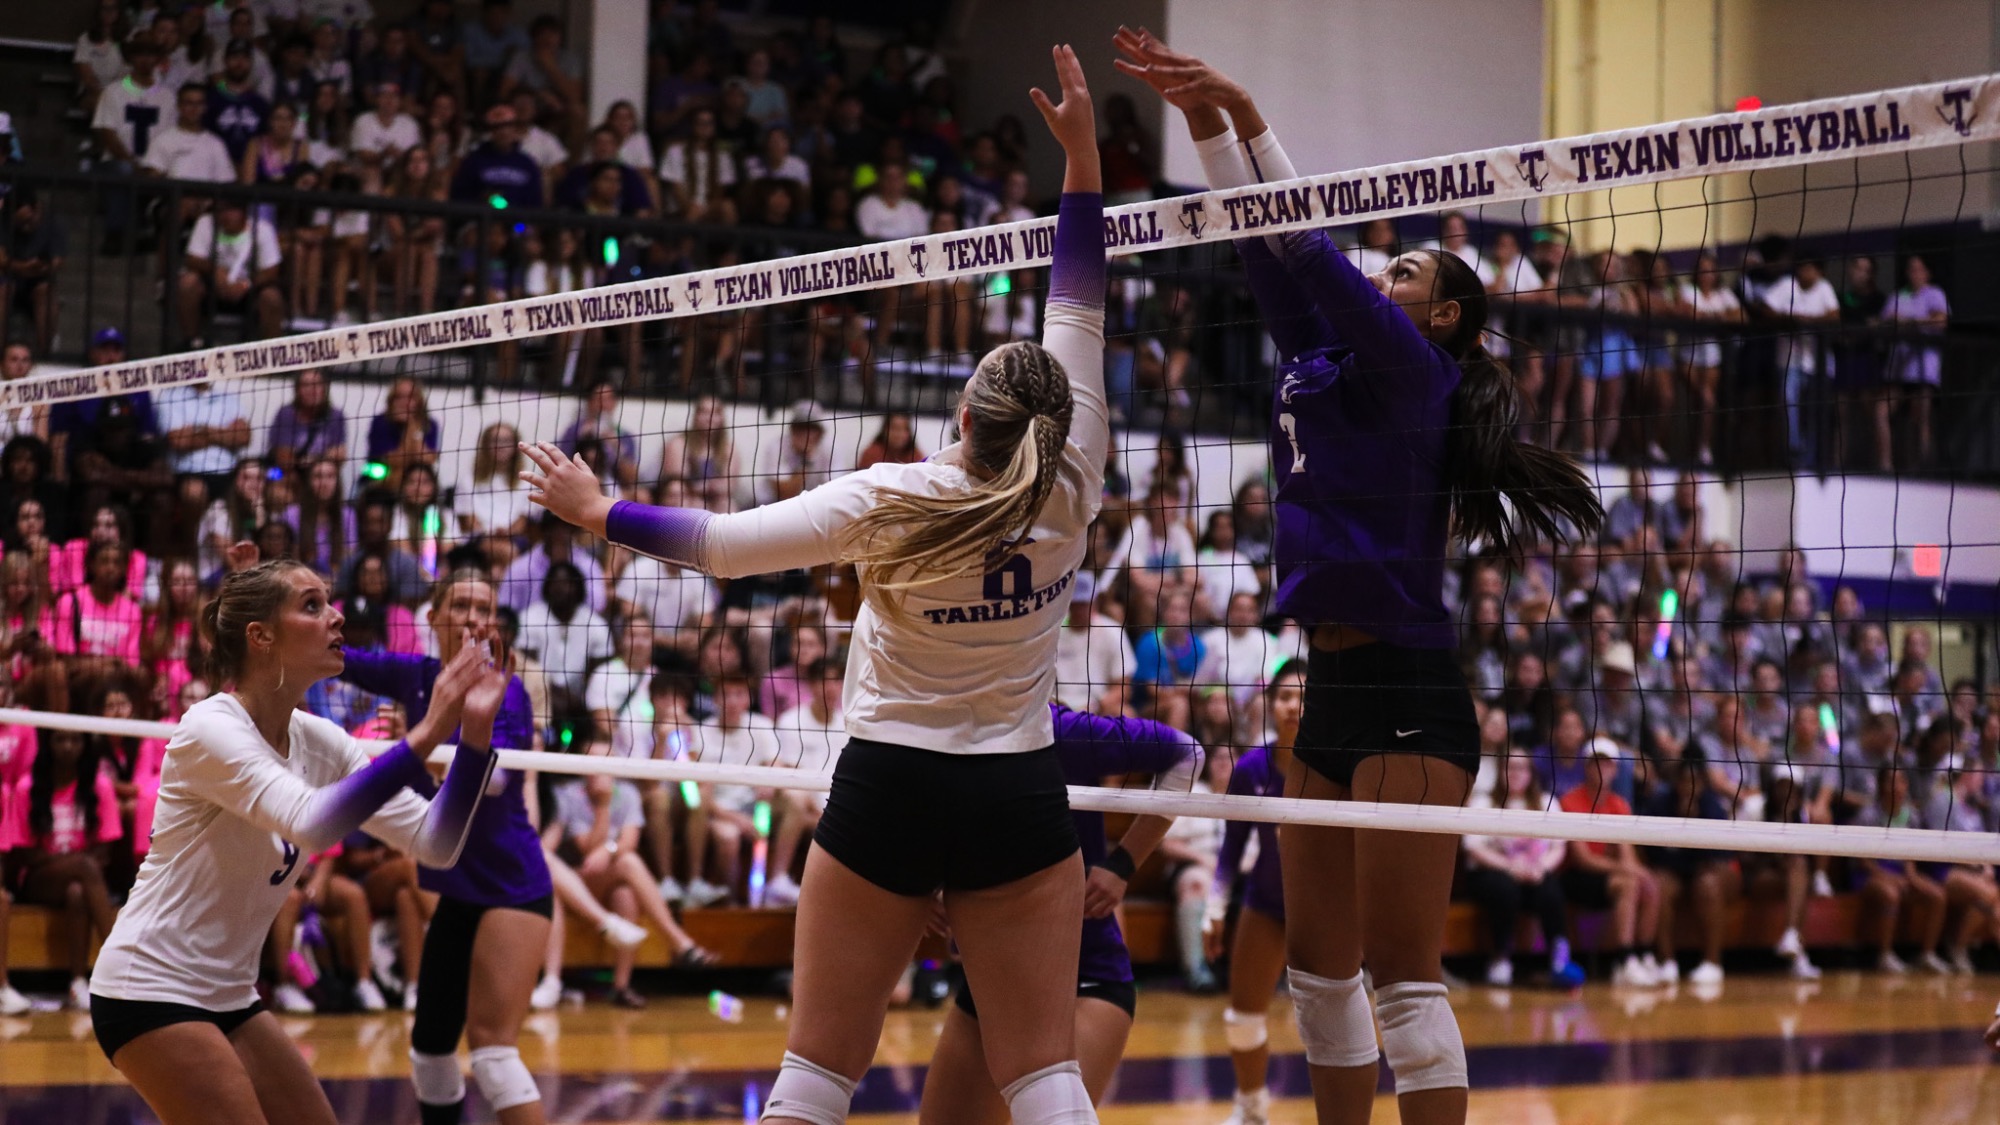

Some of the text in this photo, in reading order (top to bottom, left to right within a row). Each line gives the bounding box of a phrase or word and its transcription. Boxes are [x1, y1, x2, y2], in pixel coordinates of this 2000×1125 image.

[125, 103, 160, 157] T
[233, 345, 268, 372] TEXAN
[270, 338, 339, 367] VOLLEYBALL
[368, 326, 409, 354] TEXAN
[410, 314, 491, 348] VOLLEYBALL
[525, 300, 574, 331] TEXAN
[578, 287, 674, 323] VOLLEYBALL
[715, 271, 772, 305] TEXAN
[778, 251, 895, 296] VOLLEYBALL
[943, 232, 1014, 271] TEXAN
[1020, 211, 1163, 260] VOLBALL
[1223, 186, 1312, 231] TEXAN
[1318, 160, 1495, 218] VOLLEYBALL
[1570, 131, 1680, 183] TEXAN
[1689, 102, 1910, 166] VOLLEYBALL
[924, 569, 1074, 624] TARLETON
